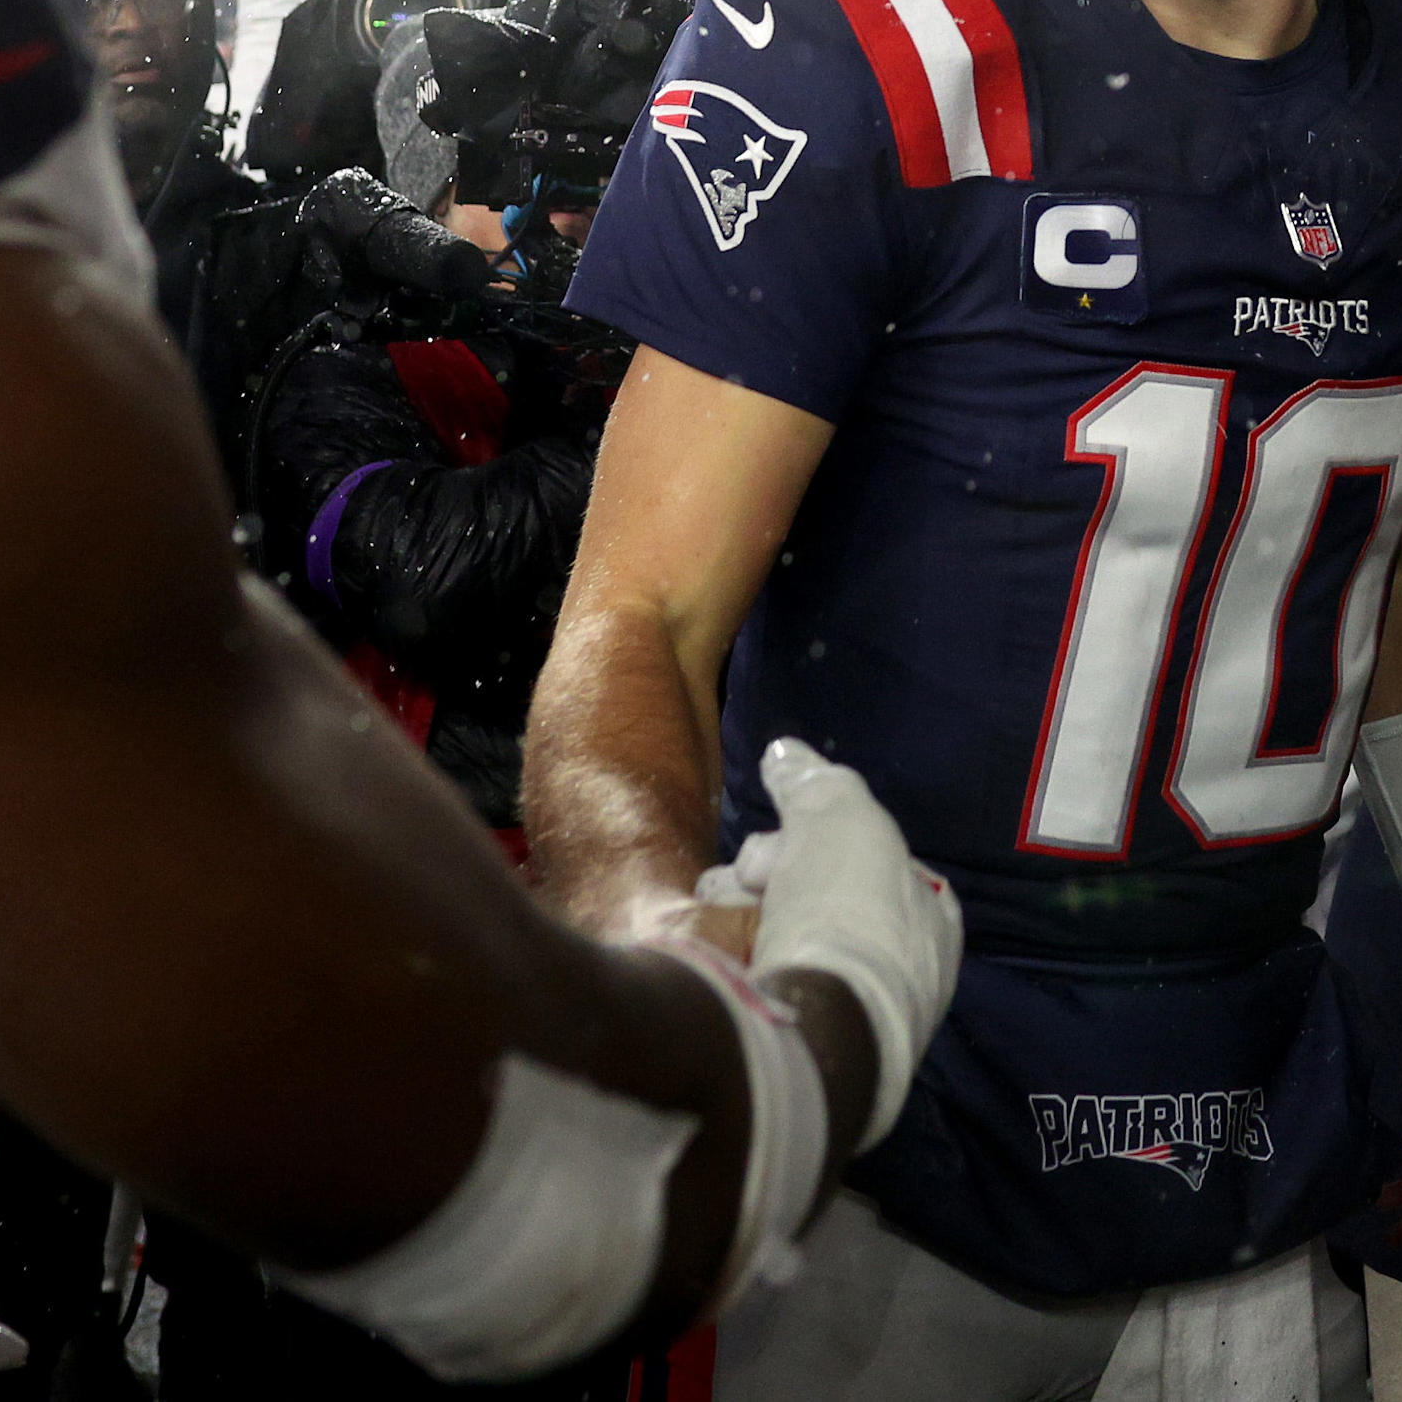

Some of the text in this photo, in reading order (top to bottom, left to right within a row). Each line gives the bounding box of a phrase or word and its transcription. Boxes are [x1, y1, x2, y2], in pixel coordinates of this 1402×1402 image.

[1034, 204, 1139, 290] C
[1298, 226, 1339, 257] NFL
[1233, 296, 1369, 336] PATRIOTS
[1029, 1087, 1275, 1173] PATRIOTS
